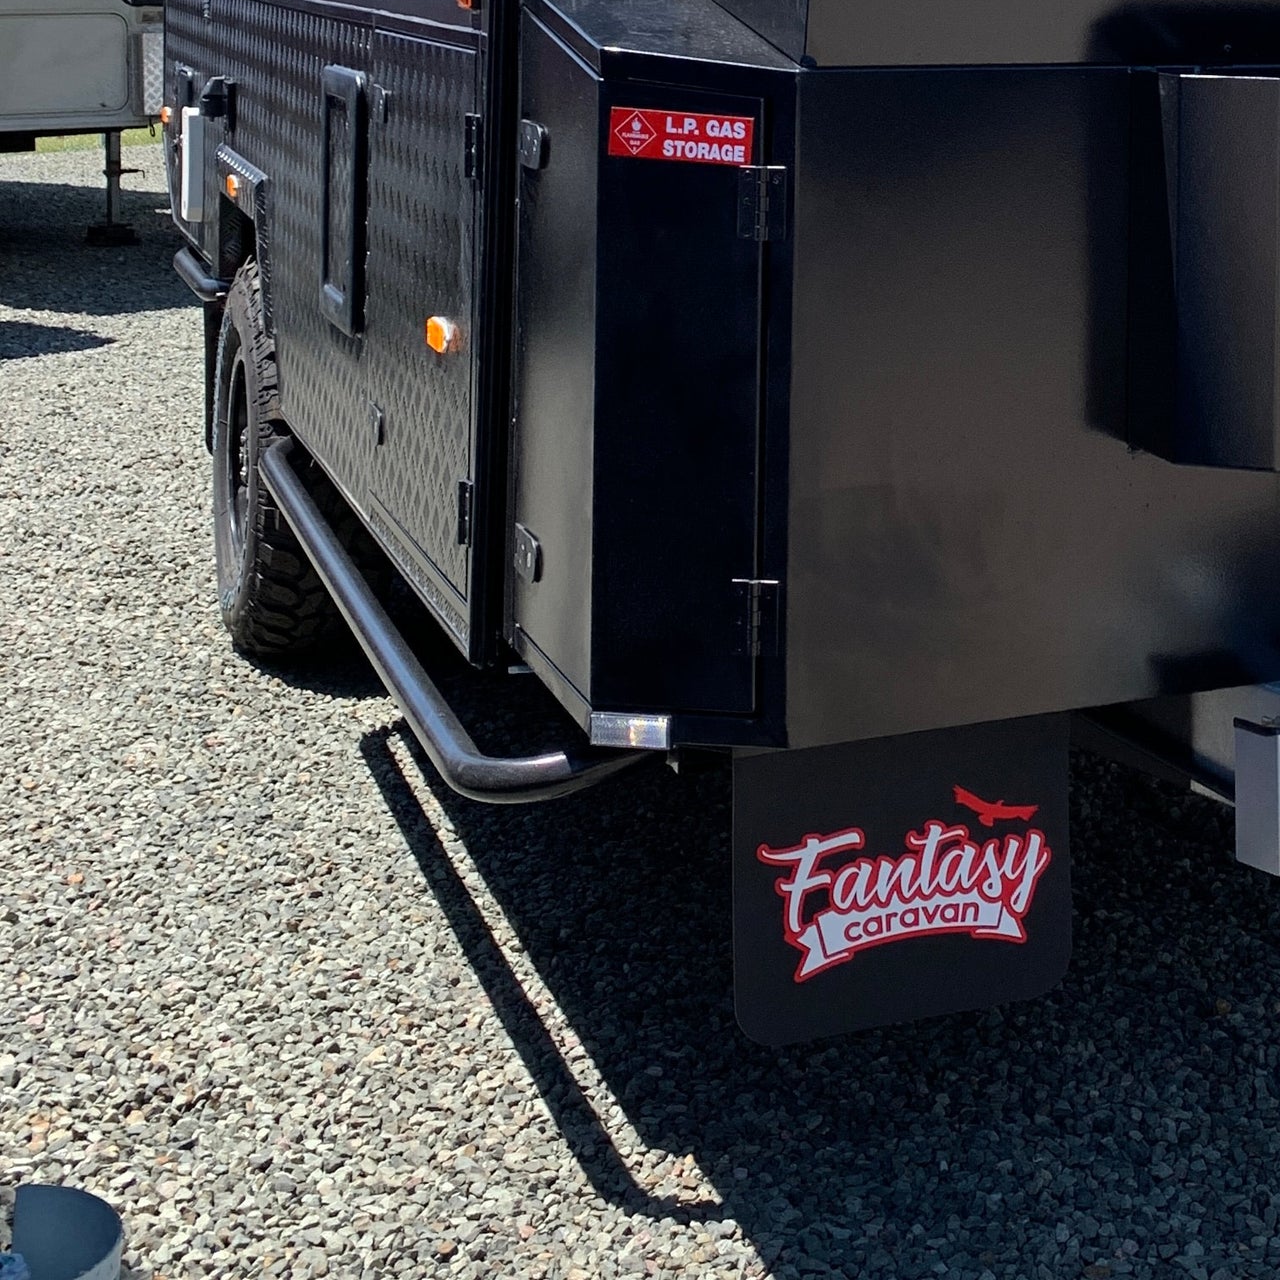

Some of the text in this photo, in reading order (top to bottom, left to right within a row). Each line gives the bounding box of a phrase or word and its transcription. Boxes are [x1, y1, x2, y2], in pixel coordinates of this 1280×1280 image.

[665, 116, 699, 136] L.P.
[705, 120, 746, 139] GAS
[662, 139, 745, 162] STORAGE
[760, 823, 1049, 934] Fantasy
[843, 902, 980, 942] caravan
